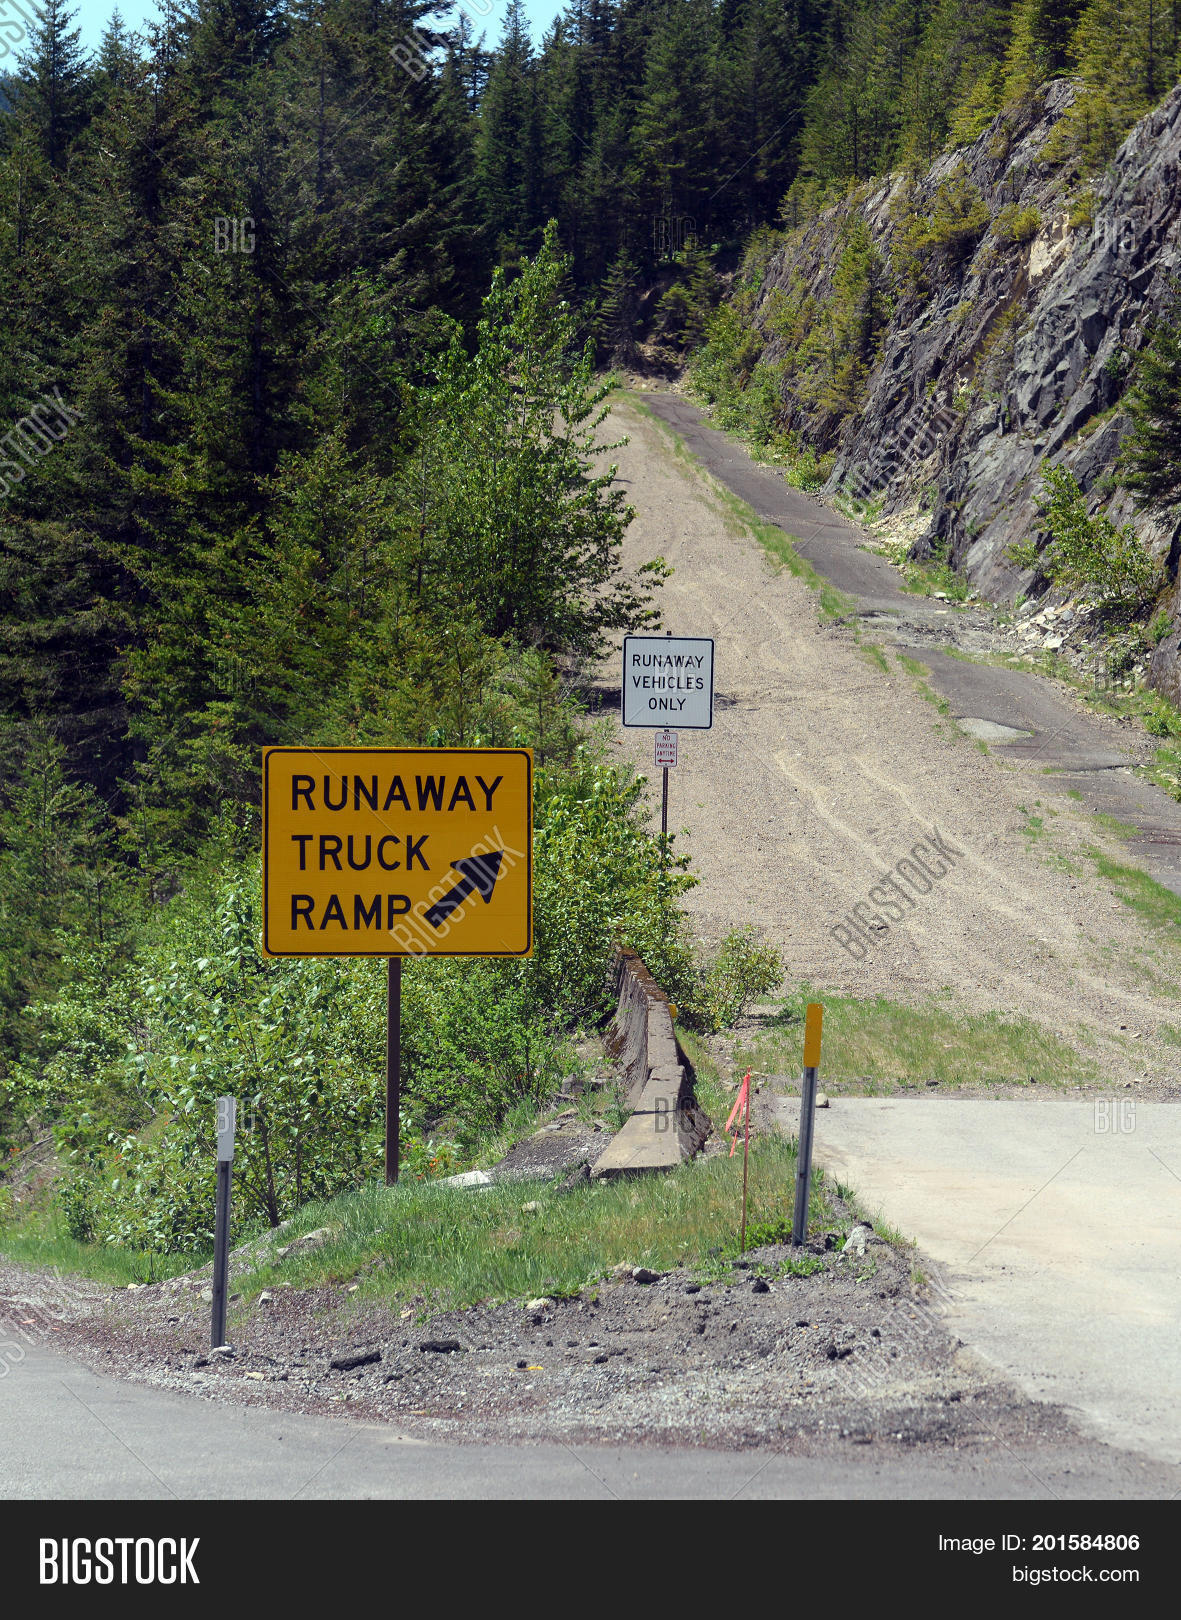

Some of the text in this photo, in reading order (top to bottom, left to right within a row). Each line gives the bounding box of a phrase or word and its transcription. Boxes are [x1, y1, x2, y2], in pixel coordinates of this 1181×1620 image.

[632, 654, 704, 669] RUNAWAY
[632, 675, 704, 690] VEHICLES
[648, 697, 687, 711] ONLY
[291, 774, 504, 812] RUNAWAY
[291, 834, 431, 871] TRUCK
[291, 894, 412, 931] RAMP
